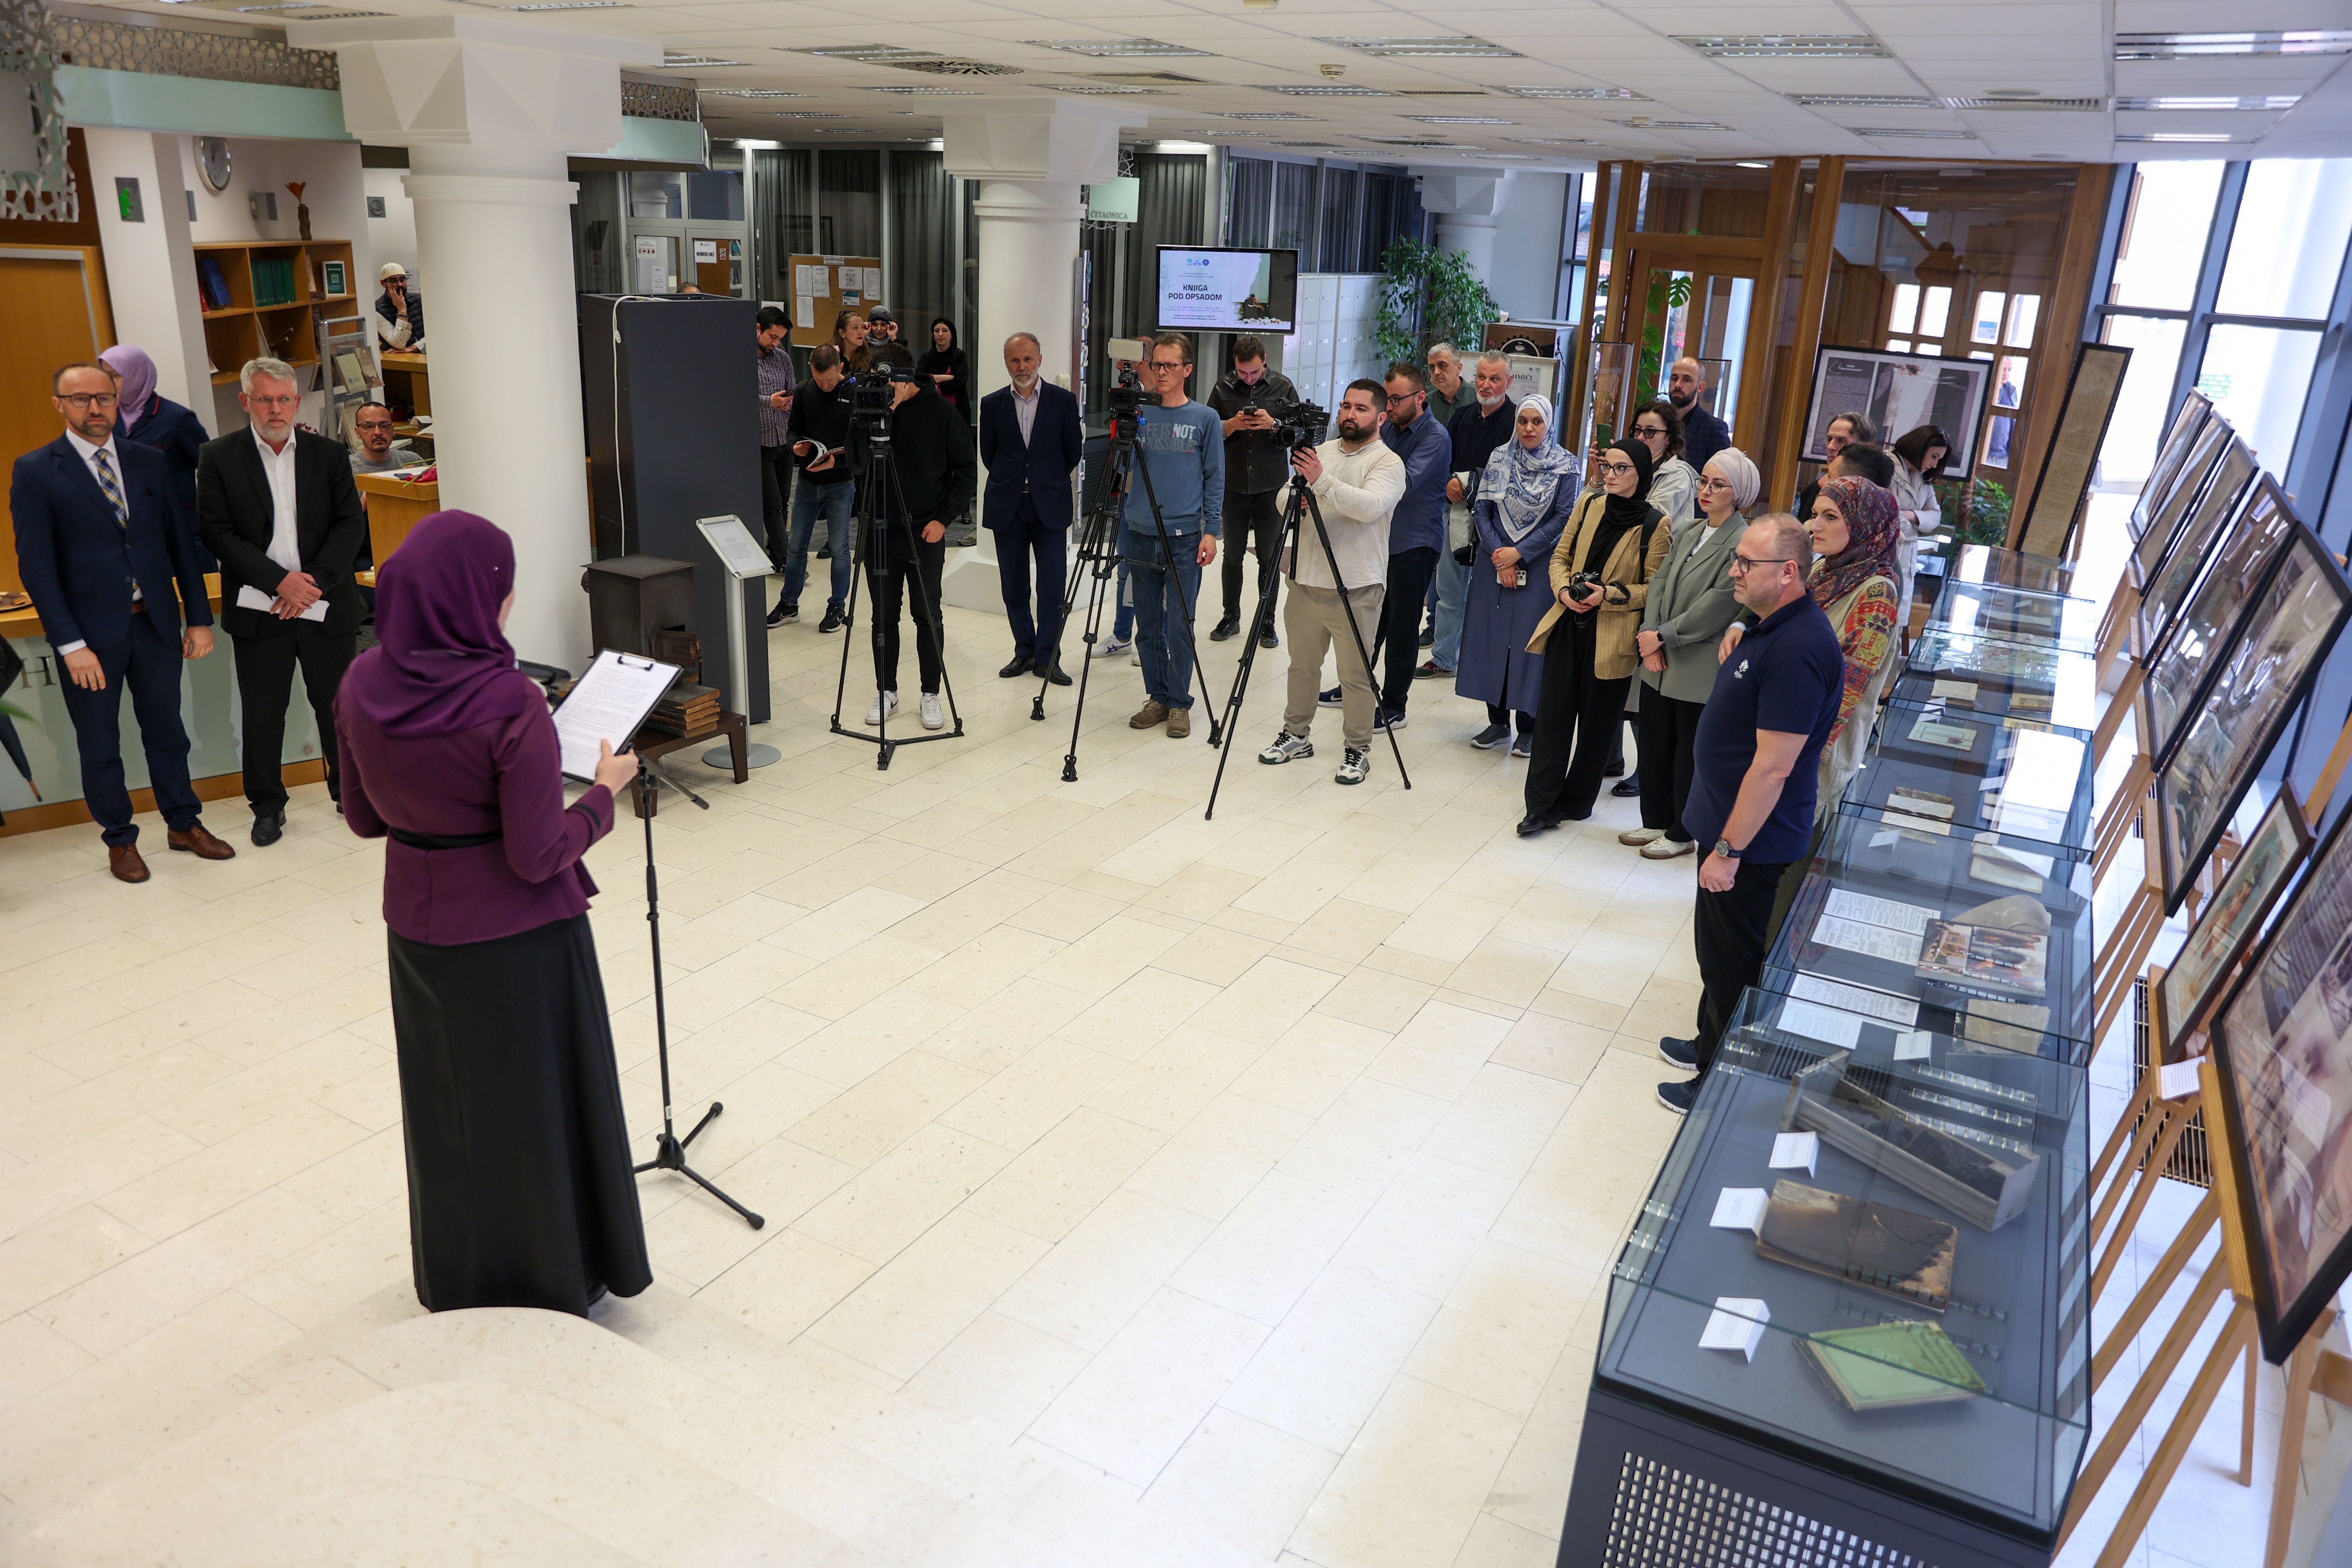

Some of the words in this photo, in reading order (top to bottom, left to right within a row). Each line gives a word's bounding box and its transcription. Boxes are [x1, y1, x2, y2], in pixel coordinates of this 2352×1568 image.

[1090, 210, 1128, 219] ČITAONICA
[1082, 307, 1089, 329] 3
[1080, 346, 1088, 367] 2
[1161, 423, 1171, 437] IS
[1172, 423, 1196, 439] NOT
